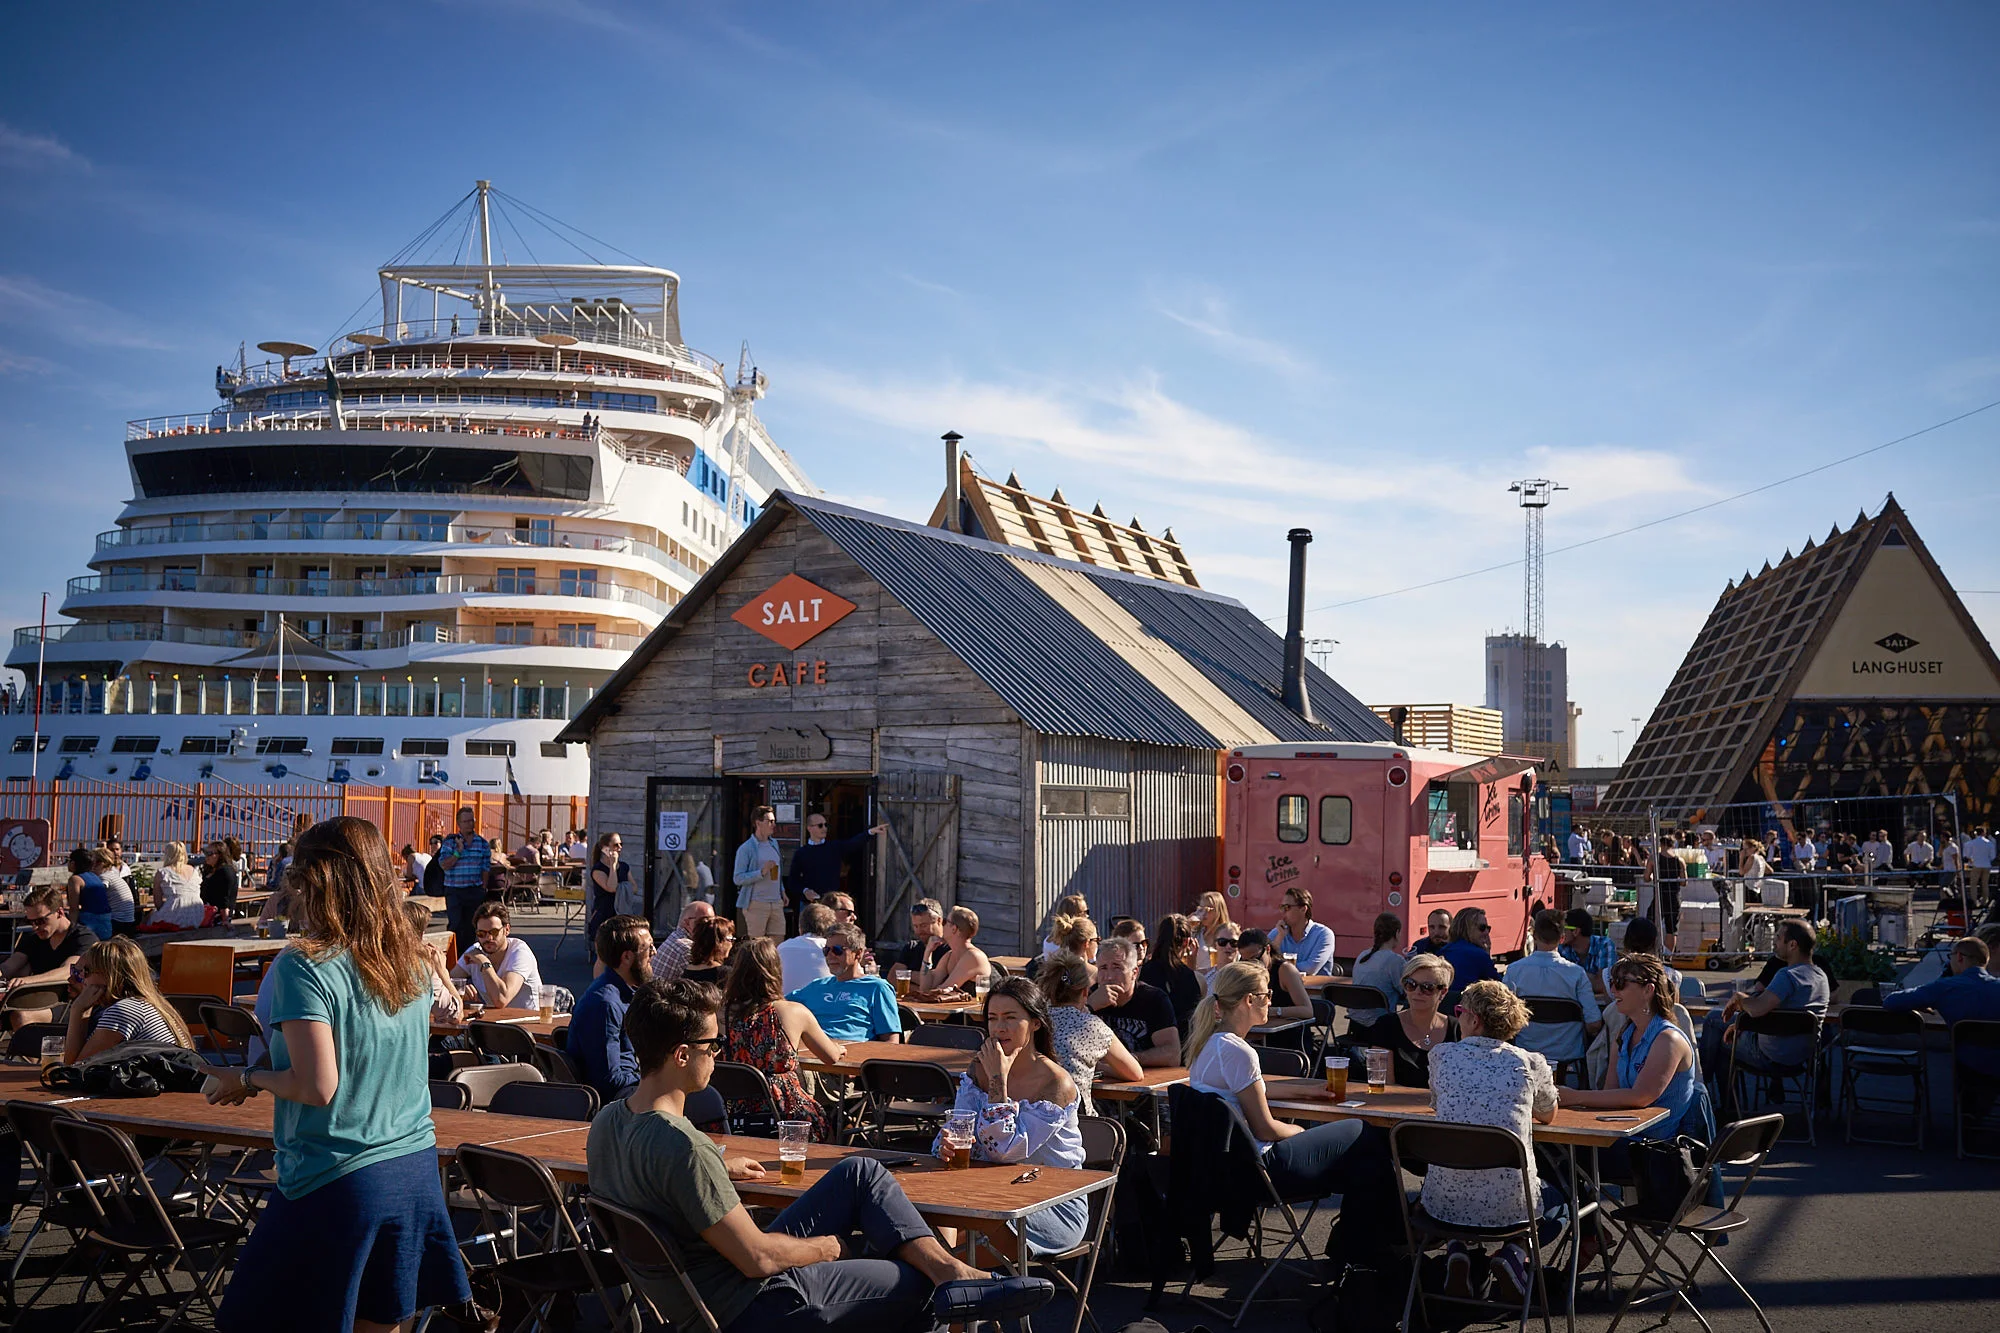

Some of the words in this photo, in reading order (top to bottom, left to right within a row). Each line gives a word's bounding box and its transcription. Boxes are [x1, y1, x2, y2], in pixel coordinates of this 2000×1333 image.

[761, 598, 823, 626] SALT
[1885, 639, 1909, 648] SALT
[747, 660, 826, 688] CAFE
[1852, 661, 1943, 674] LANGHUSET
[769, 743, 812, 759] Naustet
[160, 799, 294, 821] AIDAdiva
[1268, 855, 1293, 870] Ice
[1265, 867, 1300, 884] Crime
